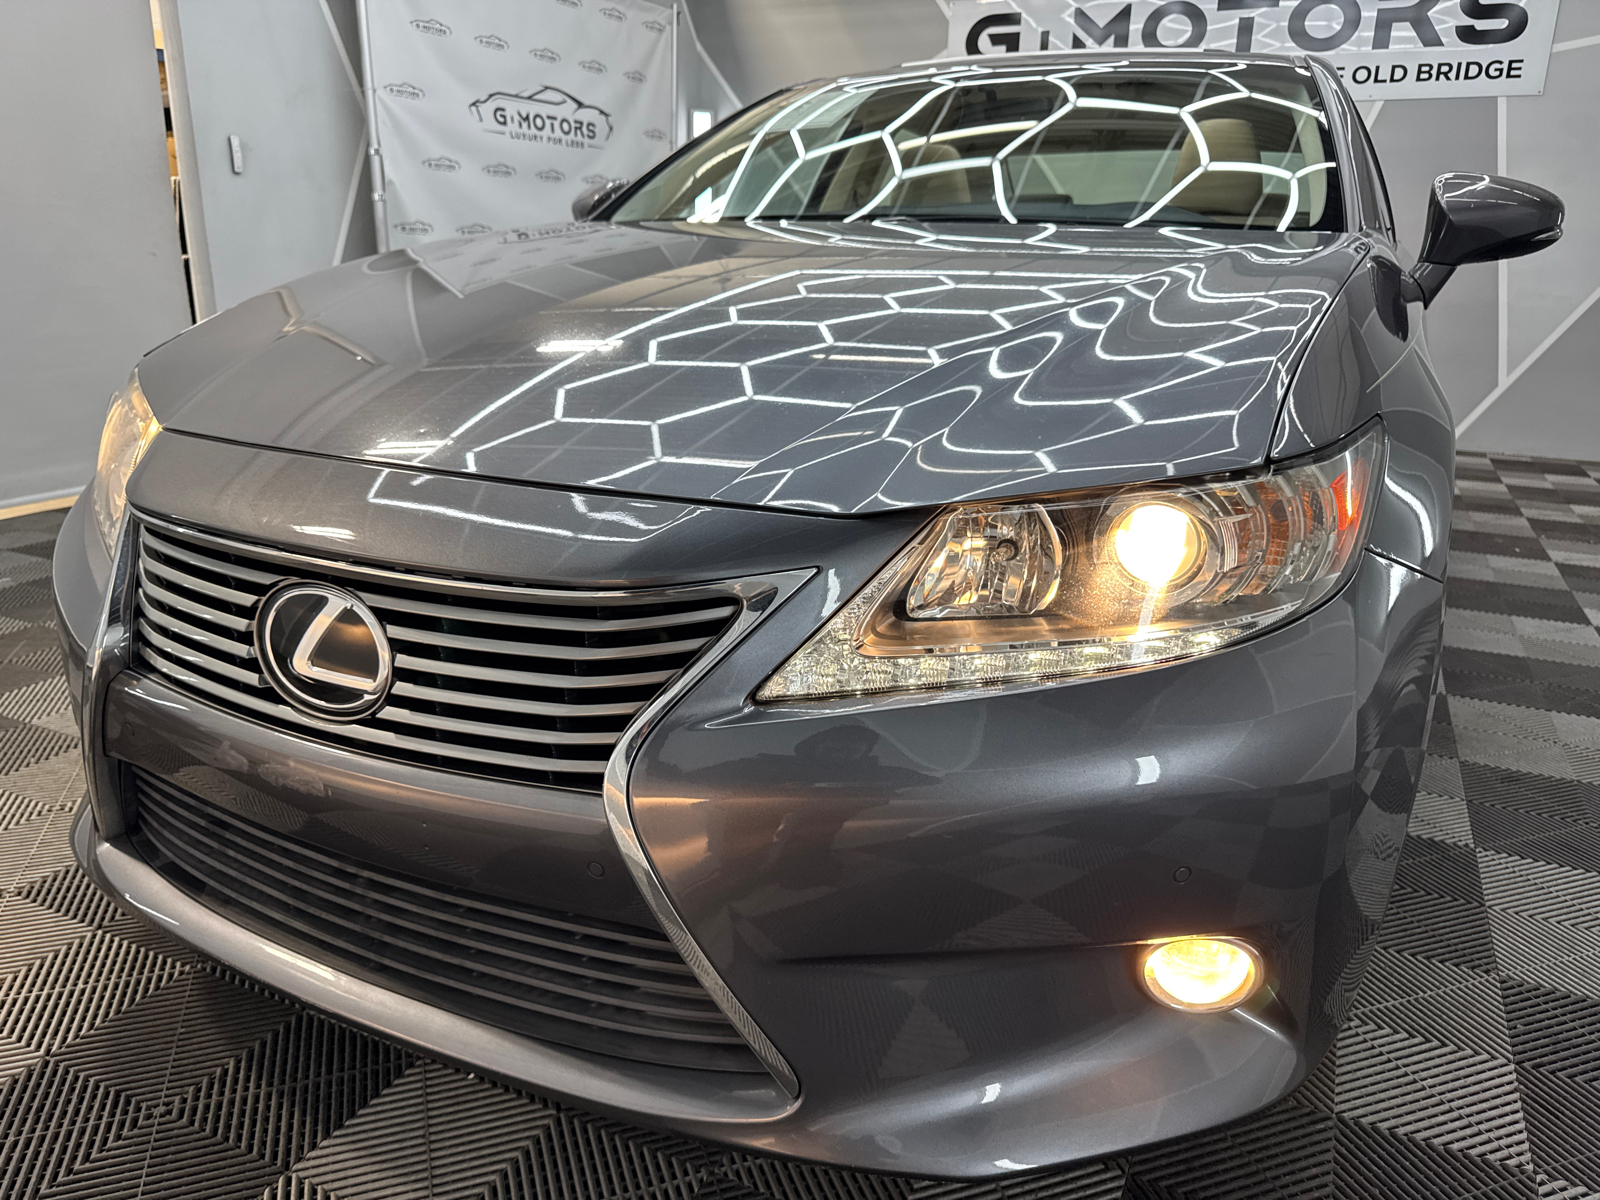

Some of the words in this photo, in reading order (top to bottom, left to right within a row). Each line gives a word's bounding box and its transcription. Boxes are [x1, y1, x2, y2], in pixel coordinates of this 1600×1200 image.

[1352, 64, 1408, 84] OLD
[1415, 59, 1524, 82] BRIDGE
[509, 130, 543, 143] LUXURY
[547, 136, 563, 146] FOR
[565, 139, 585, 149] LESS
